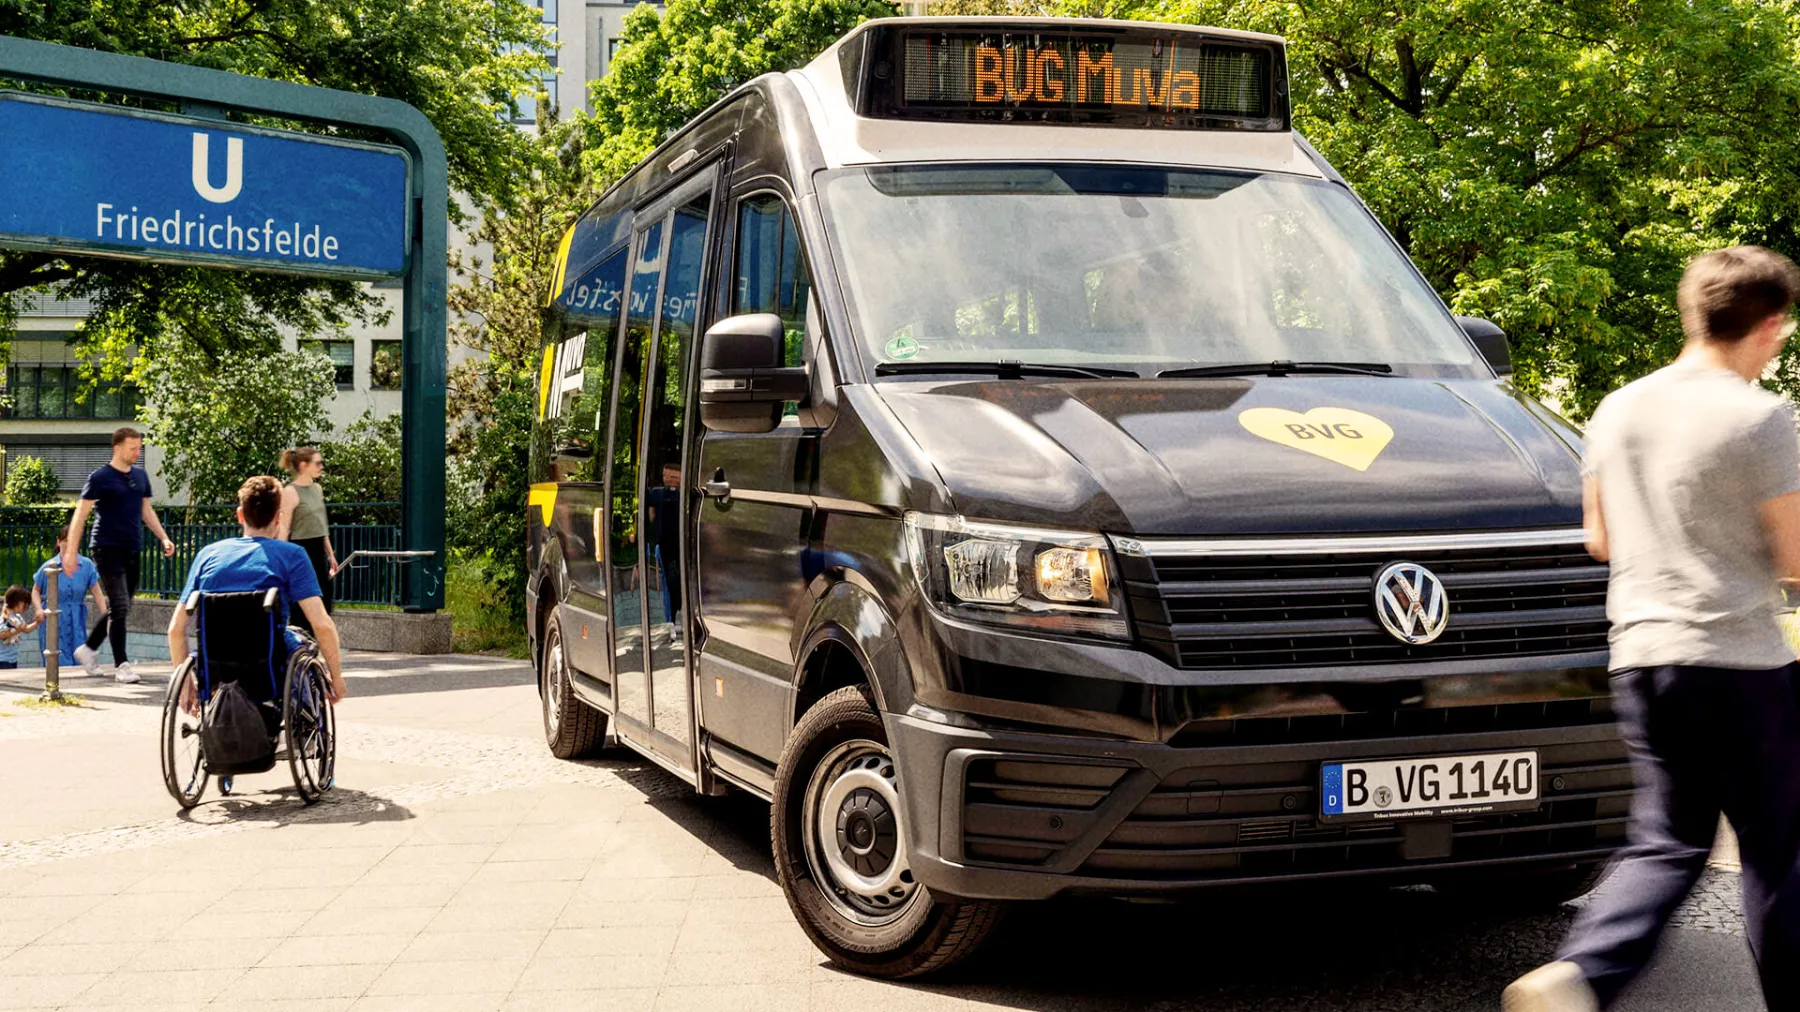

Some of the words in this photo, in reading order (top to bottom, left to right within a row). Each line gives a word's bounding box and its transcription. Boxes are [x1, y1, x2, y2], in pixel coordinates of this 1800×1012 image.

[1078, 50, 1200, 109] Muva
[192, 132, 243, 204] U
[96, 203, 339, 260] Friedrichsfelde
[1285, 423, 1364, 440] BVG
[1328, 794, 1337, 806] D
[1347, 769, 1369, 807] B
[1395, 764, 1440, 803] VG
[1449, 757, 1533, 800] 1140
